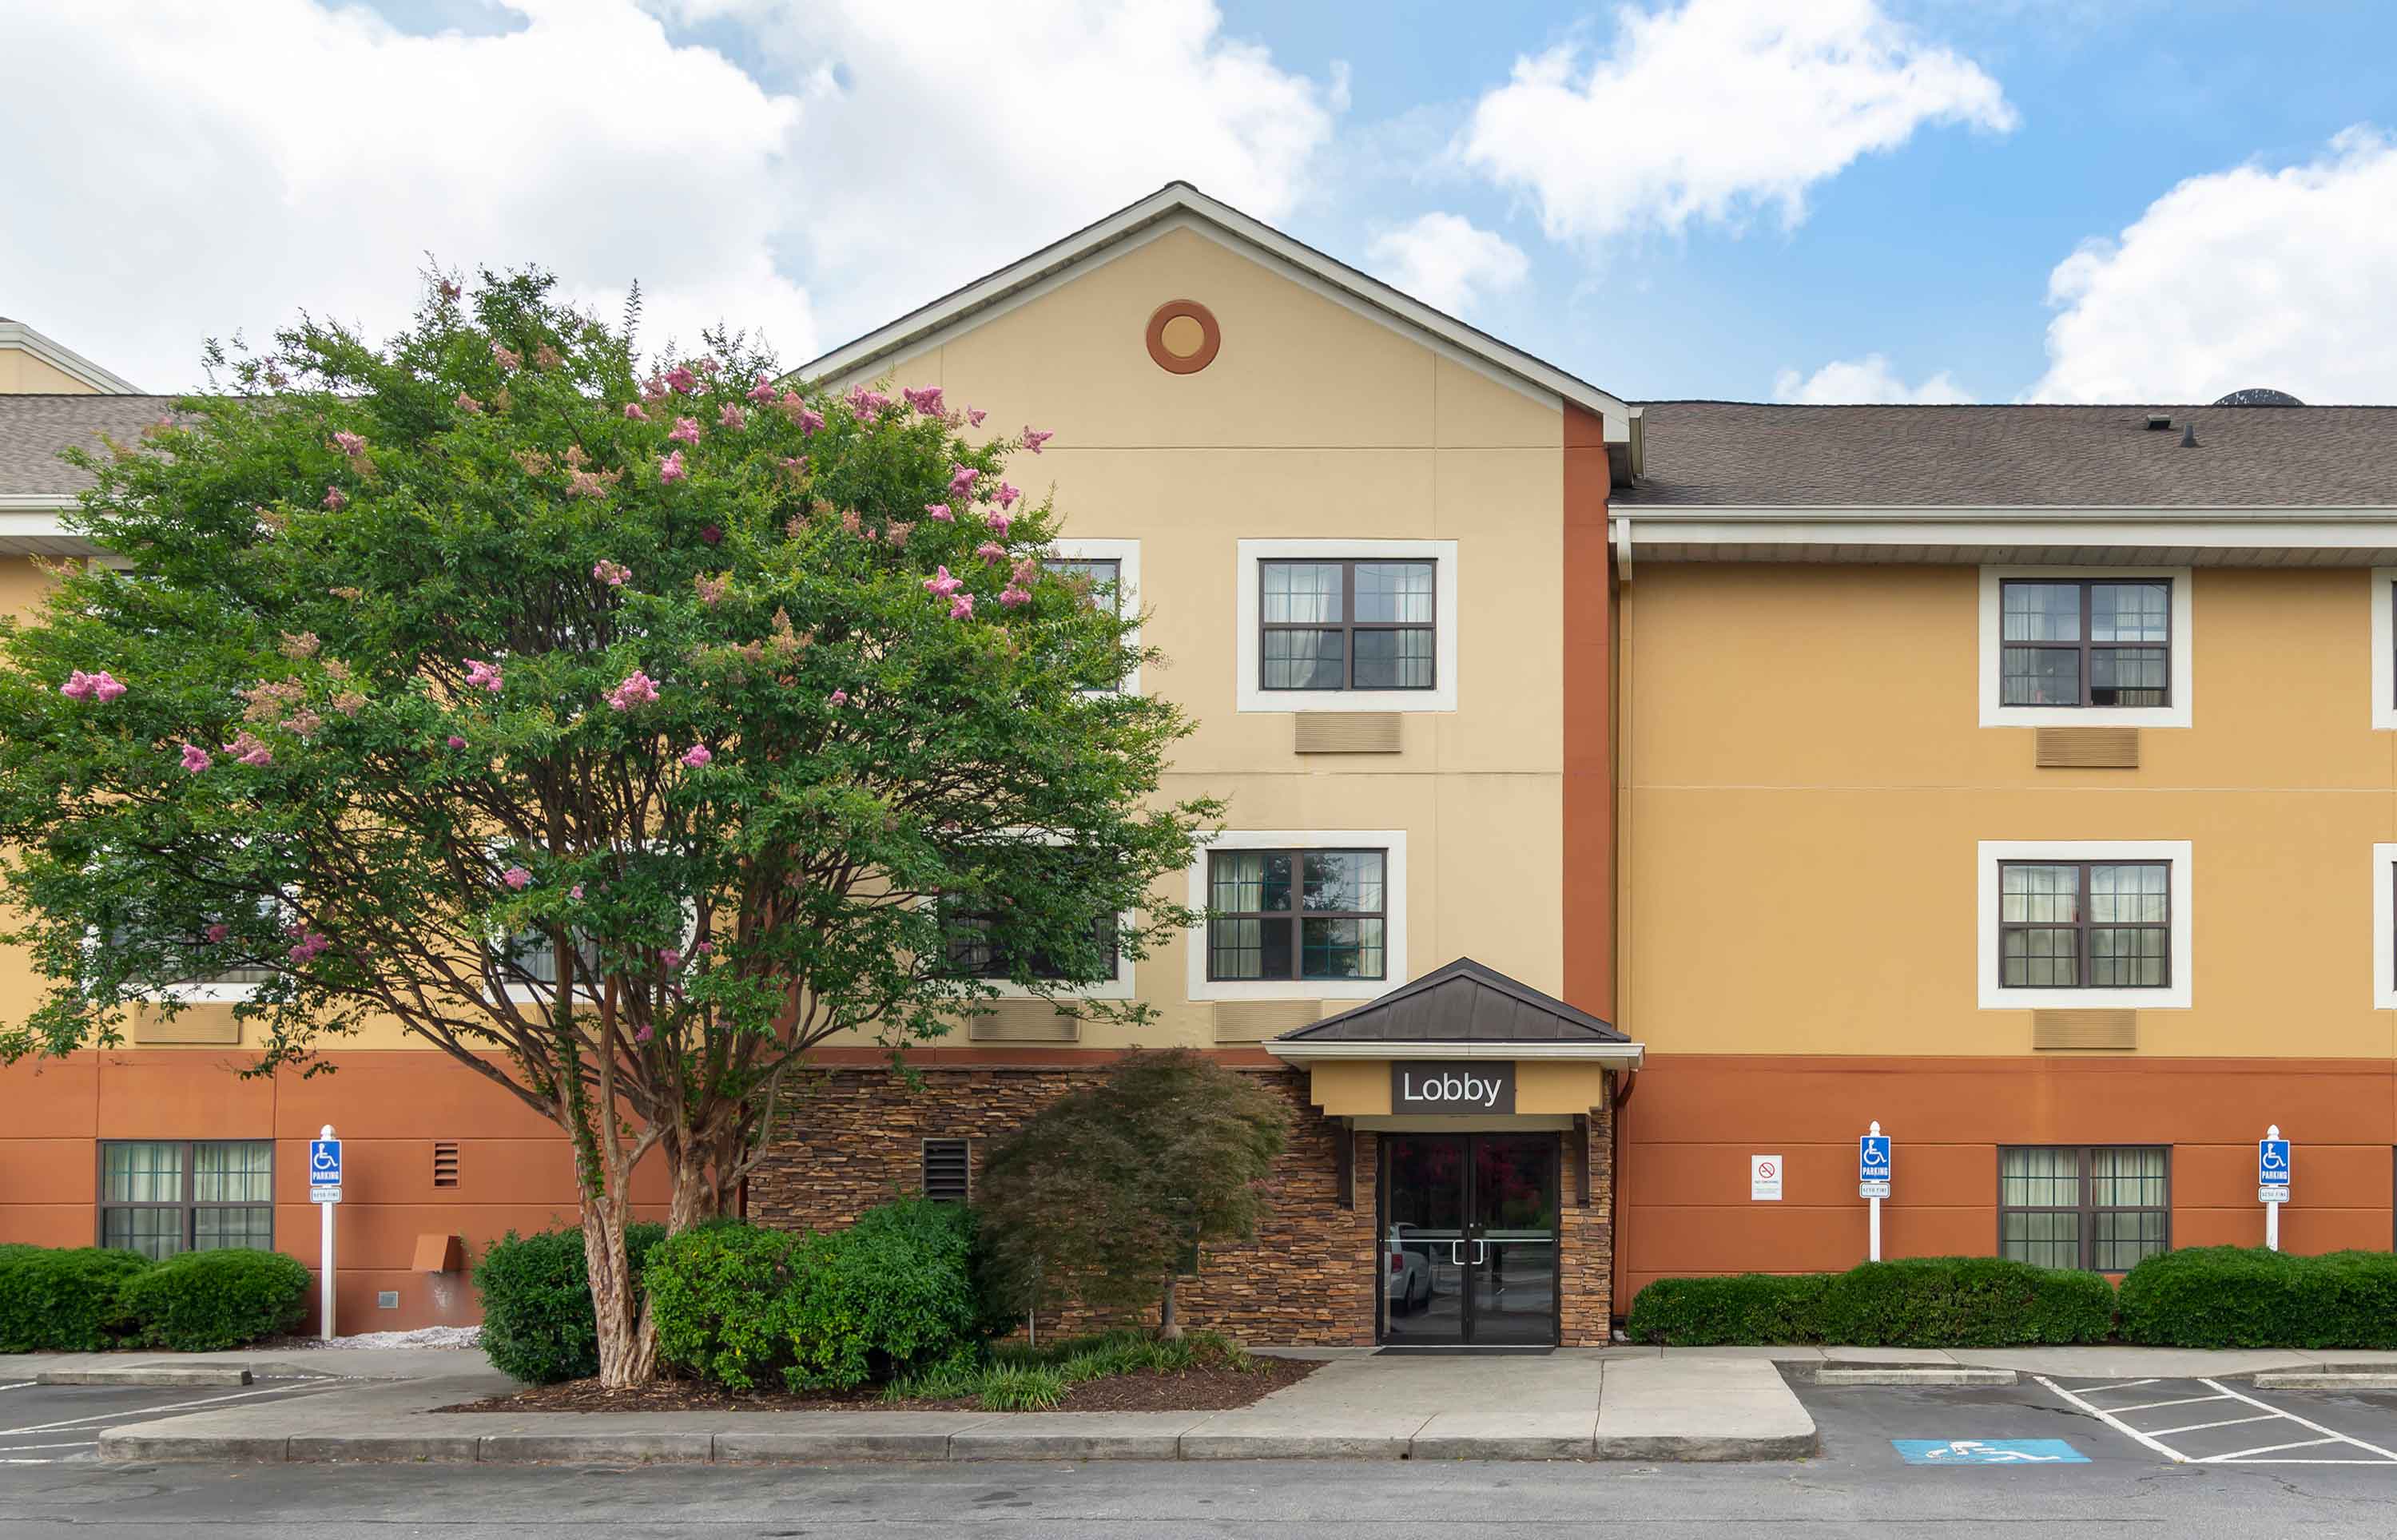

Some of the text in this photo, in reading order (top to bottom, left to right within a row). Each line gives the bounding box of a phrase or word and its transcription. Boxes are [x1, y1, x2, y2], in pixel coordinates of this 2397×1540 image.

[1404, 1073, 1502, 1107] Lobby
[312, 1171, 340, 1180] PARKING
[1862, 1167, 1888, 1176] PARKING
[2262, 1170, 2288, 1180] PARKING
